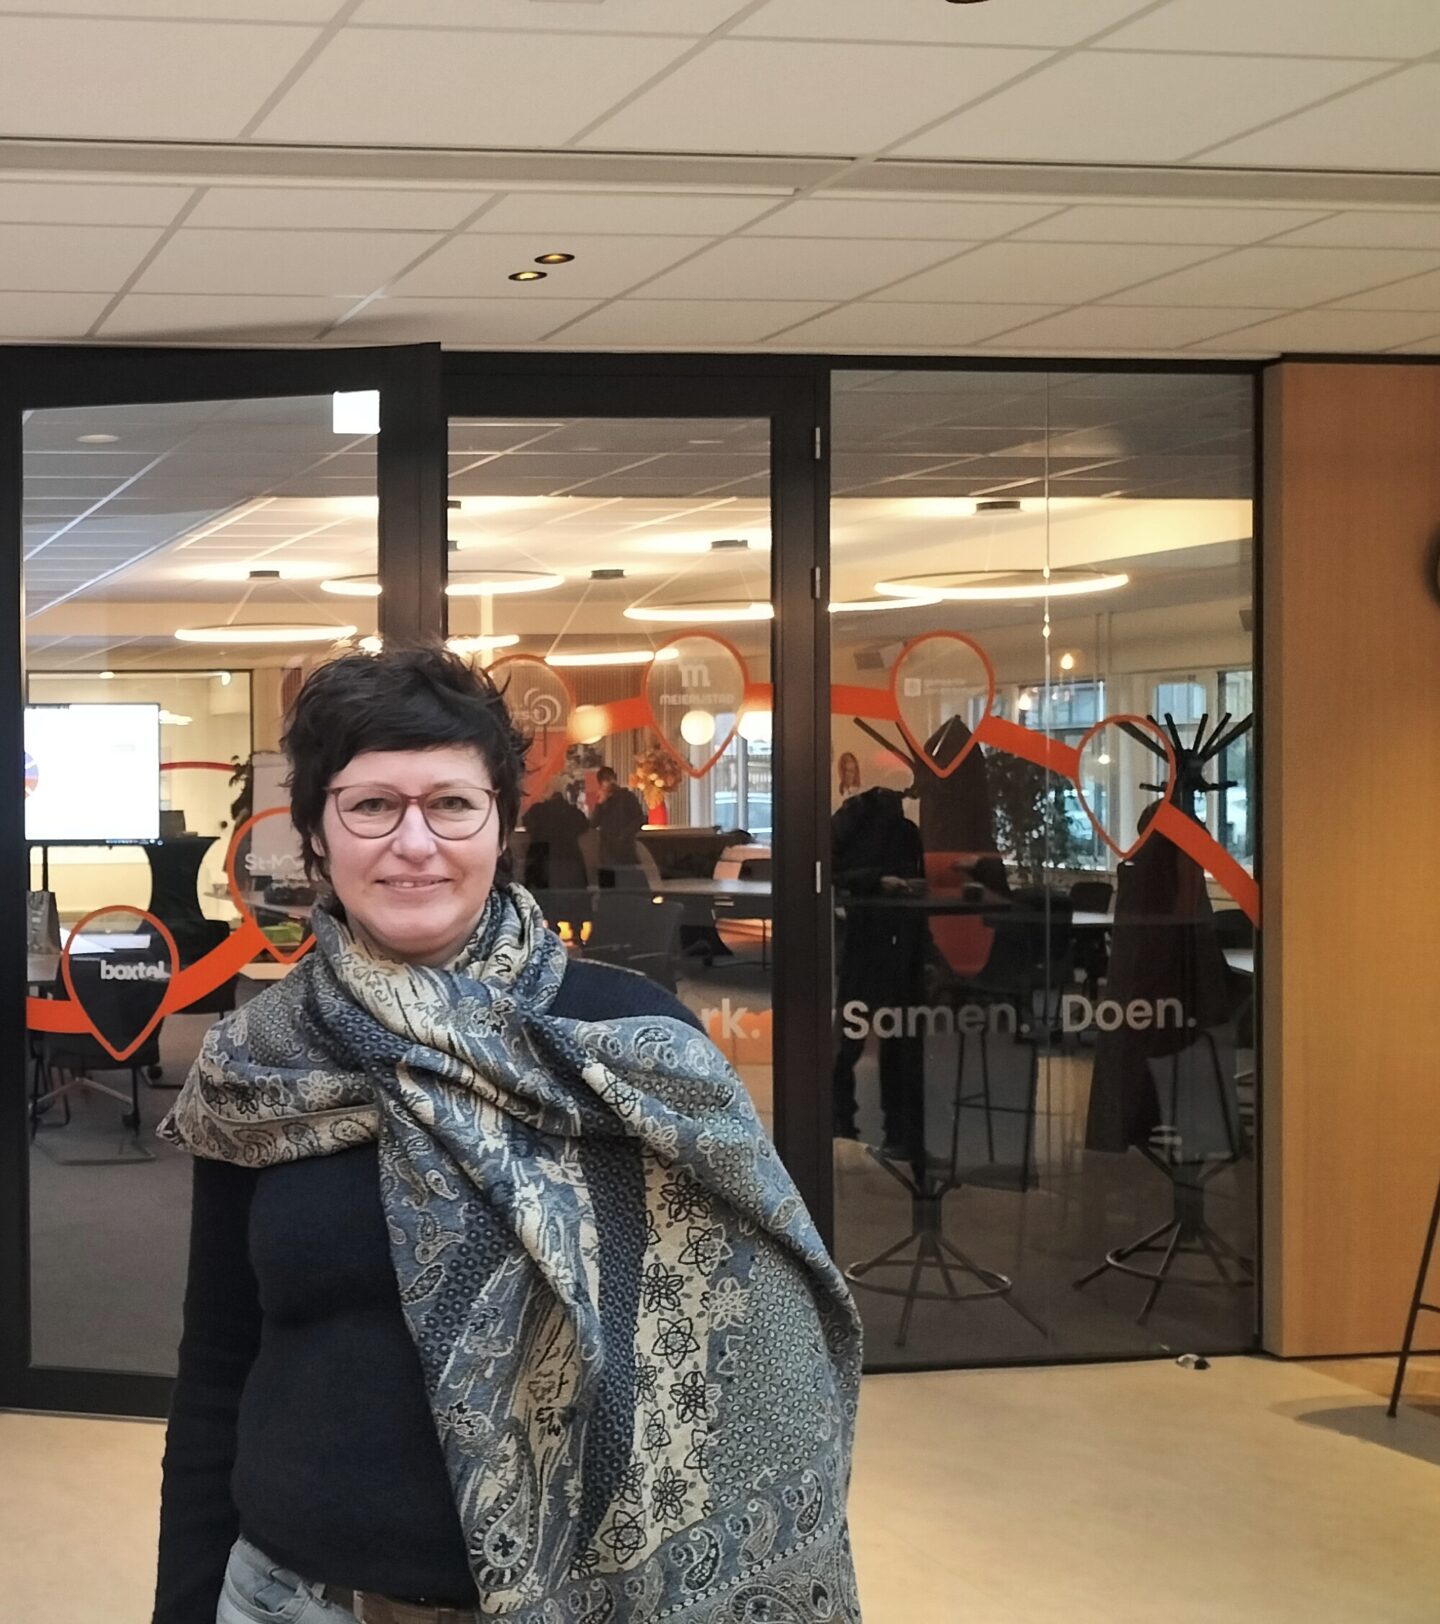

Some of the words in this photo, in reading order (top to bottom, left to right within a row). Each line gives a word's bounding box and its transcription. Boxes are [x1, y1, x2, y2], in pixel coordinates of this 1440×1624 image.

[701, 998, 760, 1039] rk.
[842, 1000, 1031, 1040] Samen.
[1061, 994, 1197, 1033] Doen.
